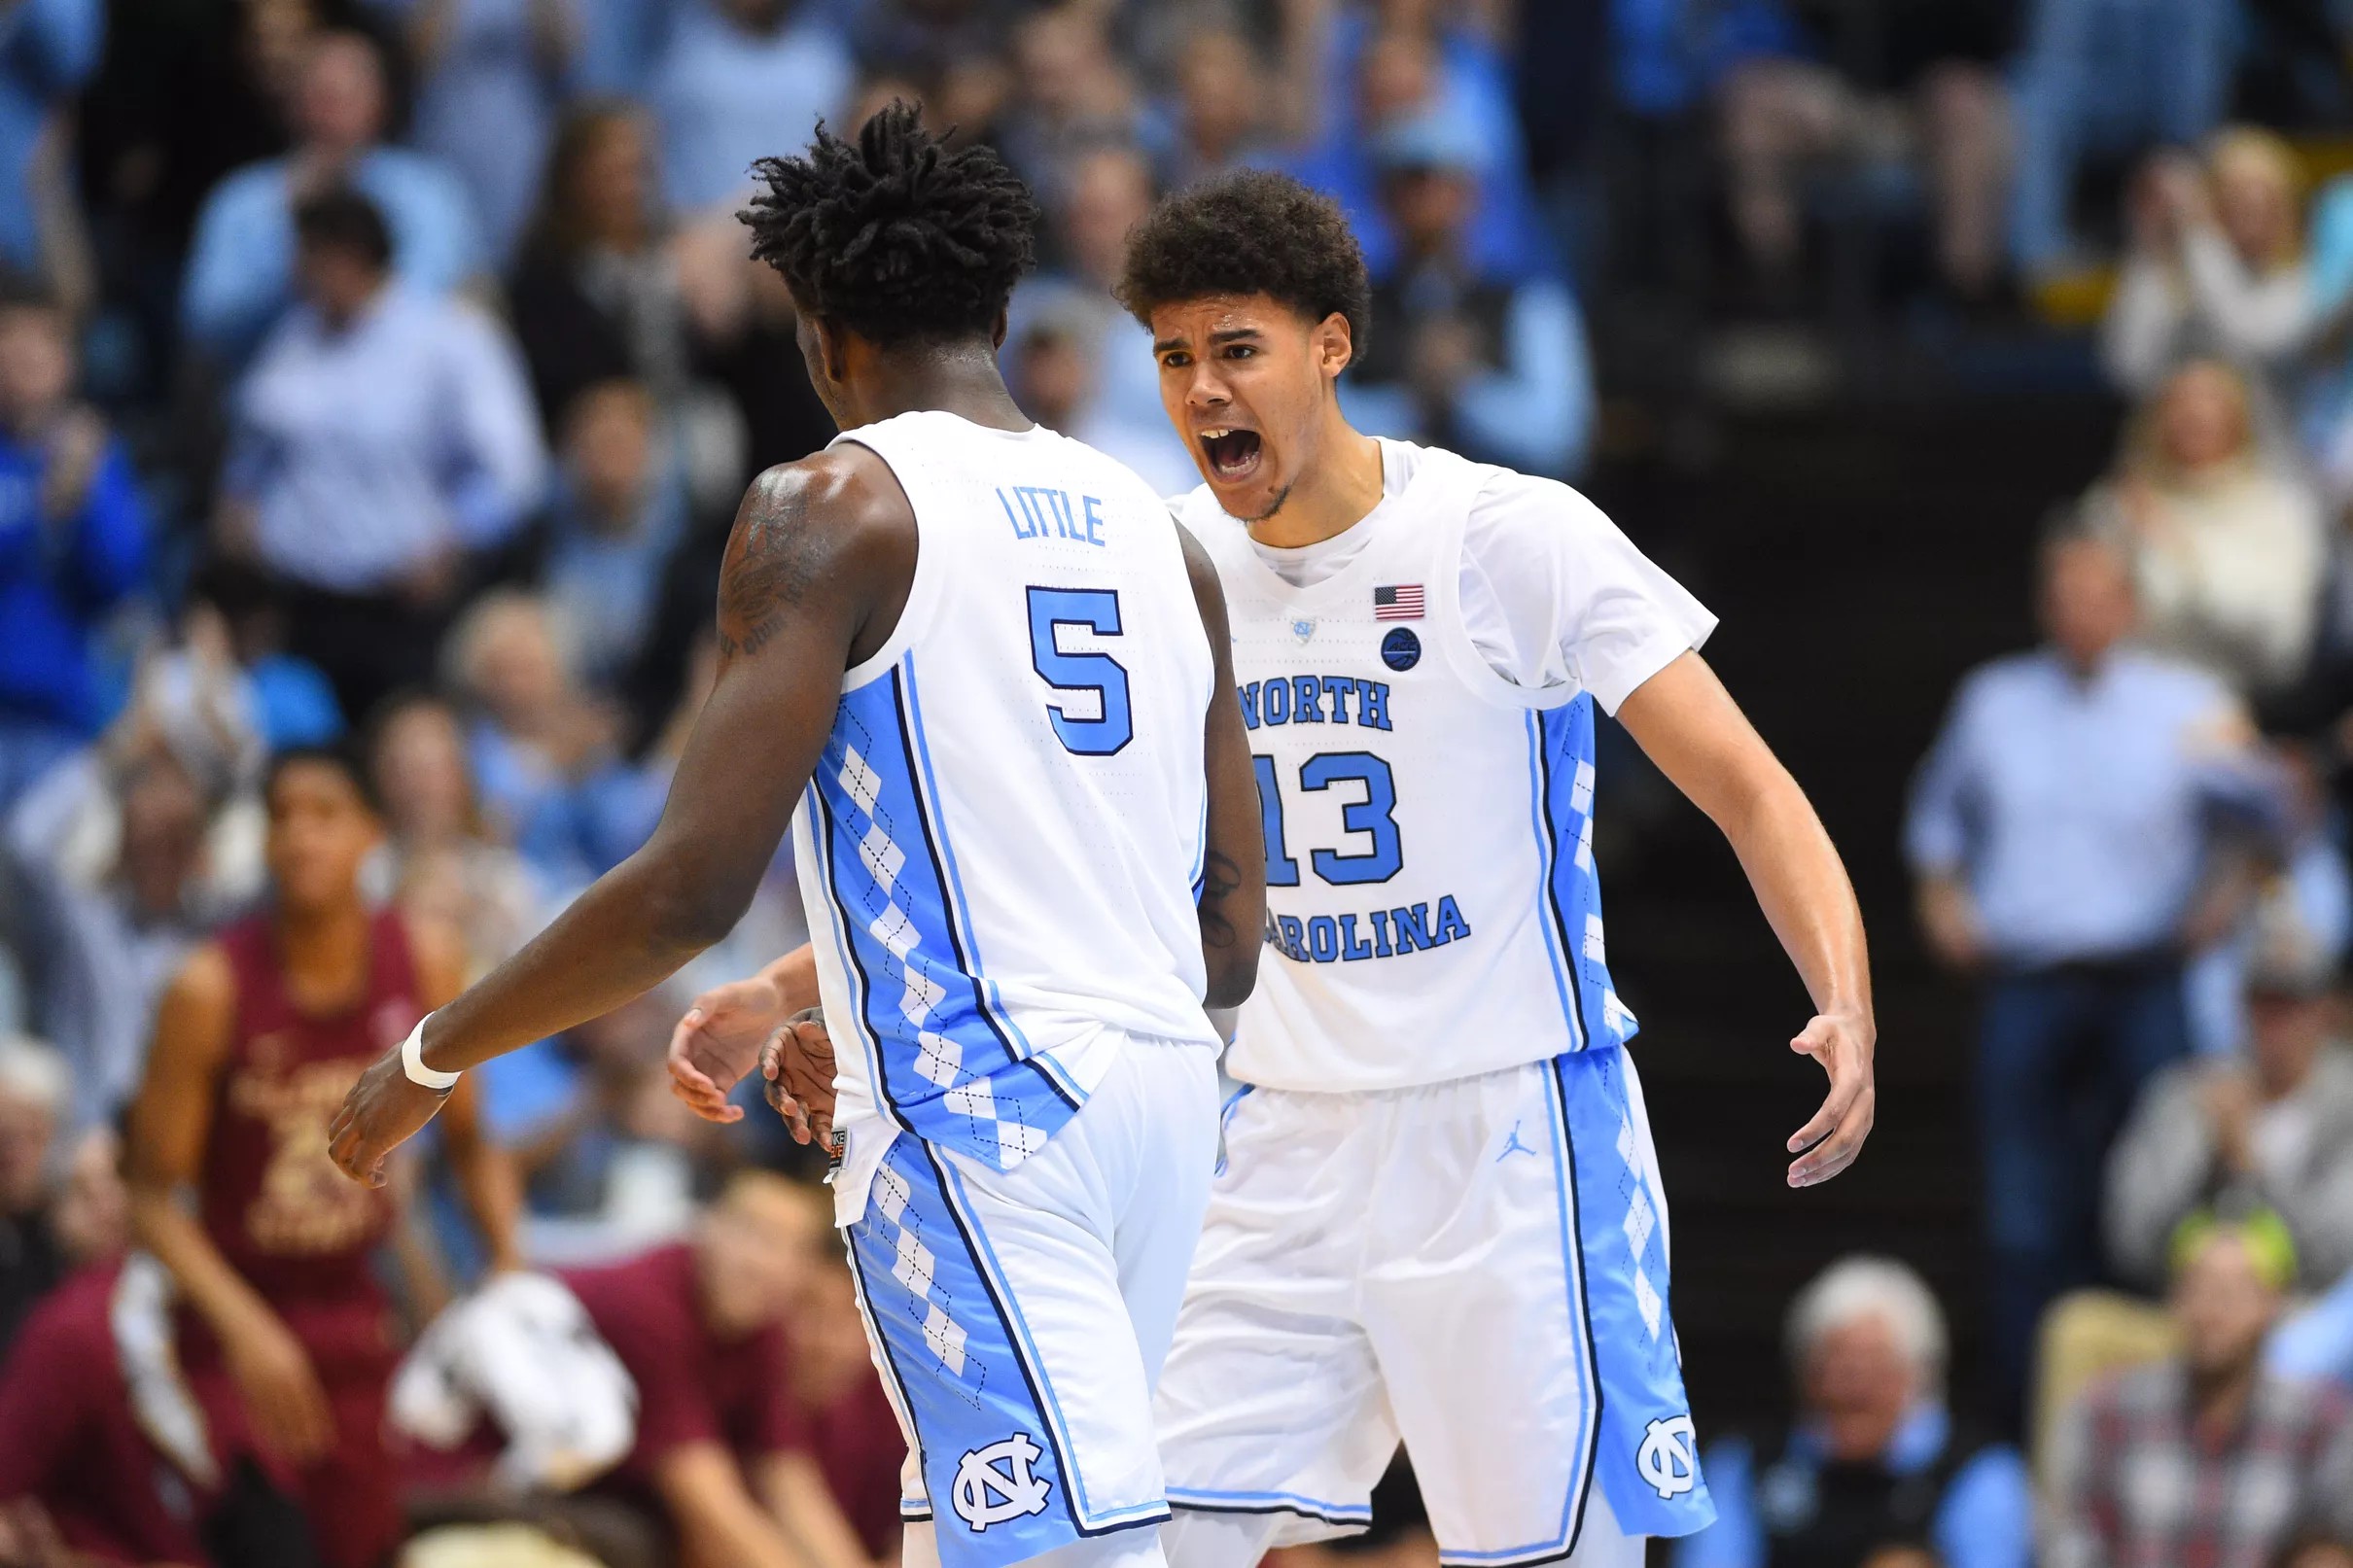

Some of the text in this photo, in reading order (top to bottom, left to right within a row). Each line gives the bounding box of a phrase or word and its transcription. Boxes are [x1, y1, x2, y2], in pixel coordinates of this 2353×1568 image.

[995, 486, 1106, 547] LITTLE
[1026, 585, 1134, 756] 5
[1238, 675, 1393, 731] NORTH
[1252, 750, 1403, 887] 13
